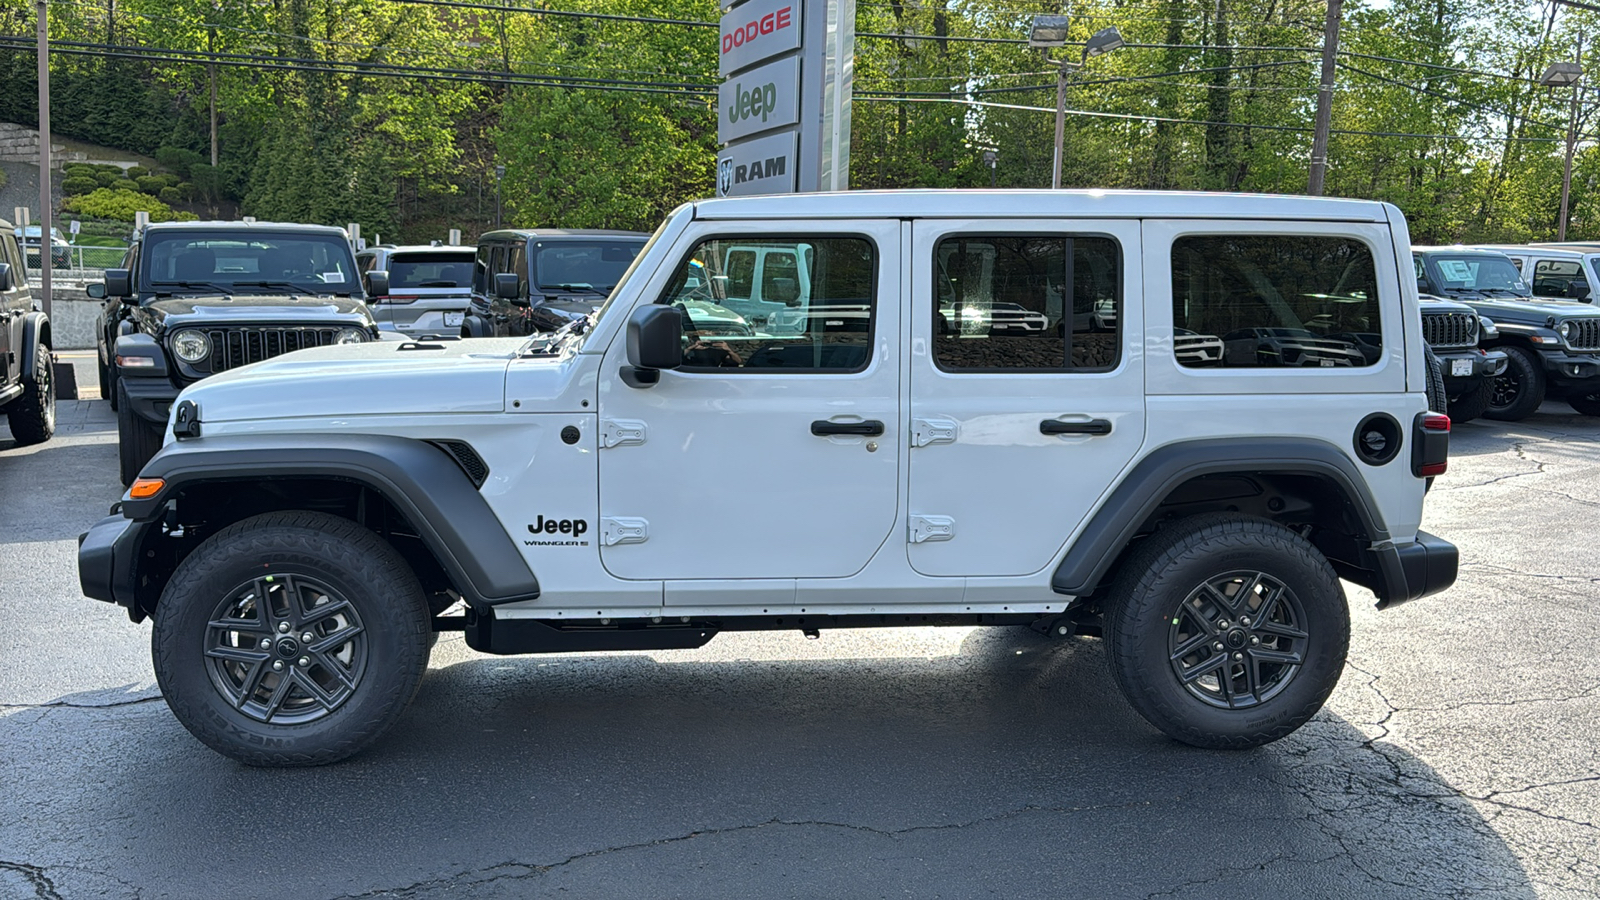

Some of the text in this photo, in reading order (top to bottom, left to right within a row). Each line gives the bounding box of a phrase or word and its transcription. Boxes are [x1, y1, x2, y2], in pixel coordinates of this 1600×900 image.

[722, 6, 791, 55] DODGE
[728, 82, 777, 124] Jeep
[734, 155, 786, 184] RAM
[527, 515, 587, 537] Jeep
